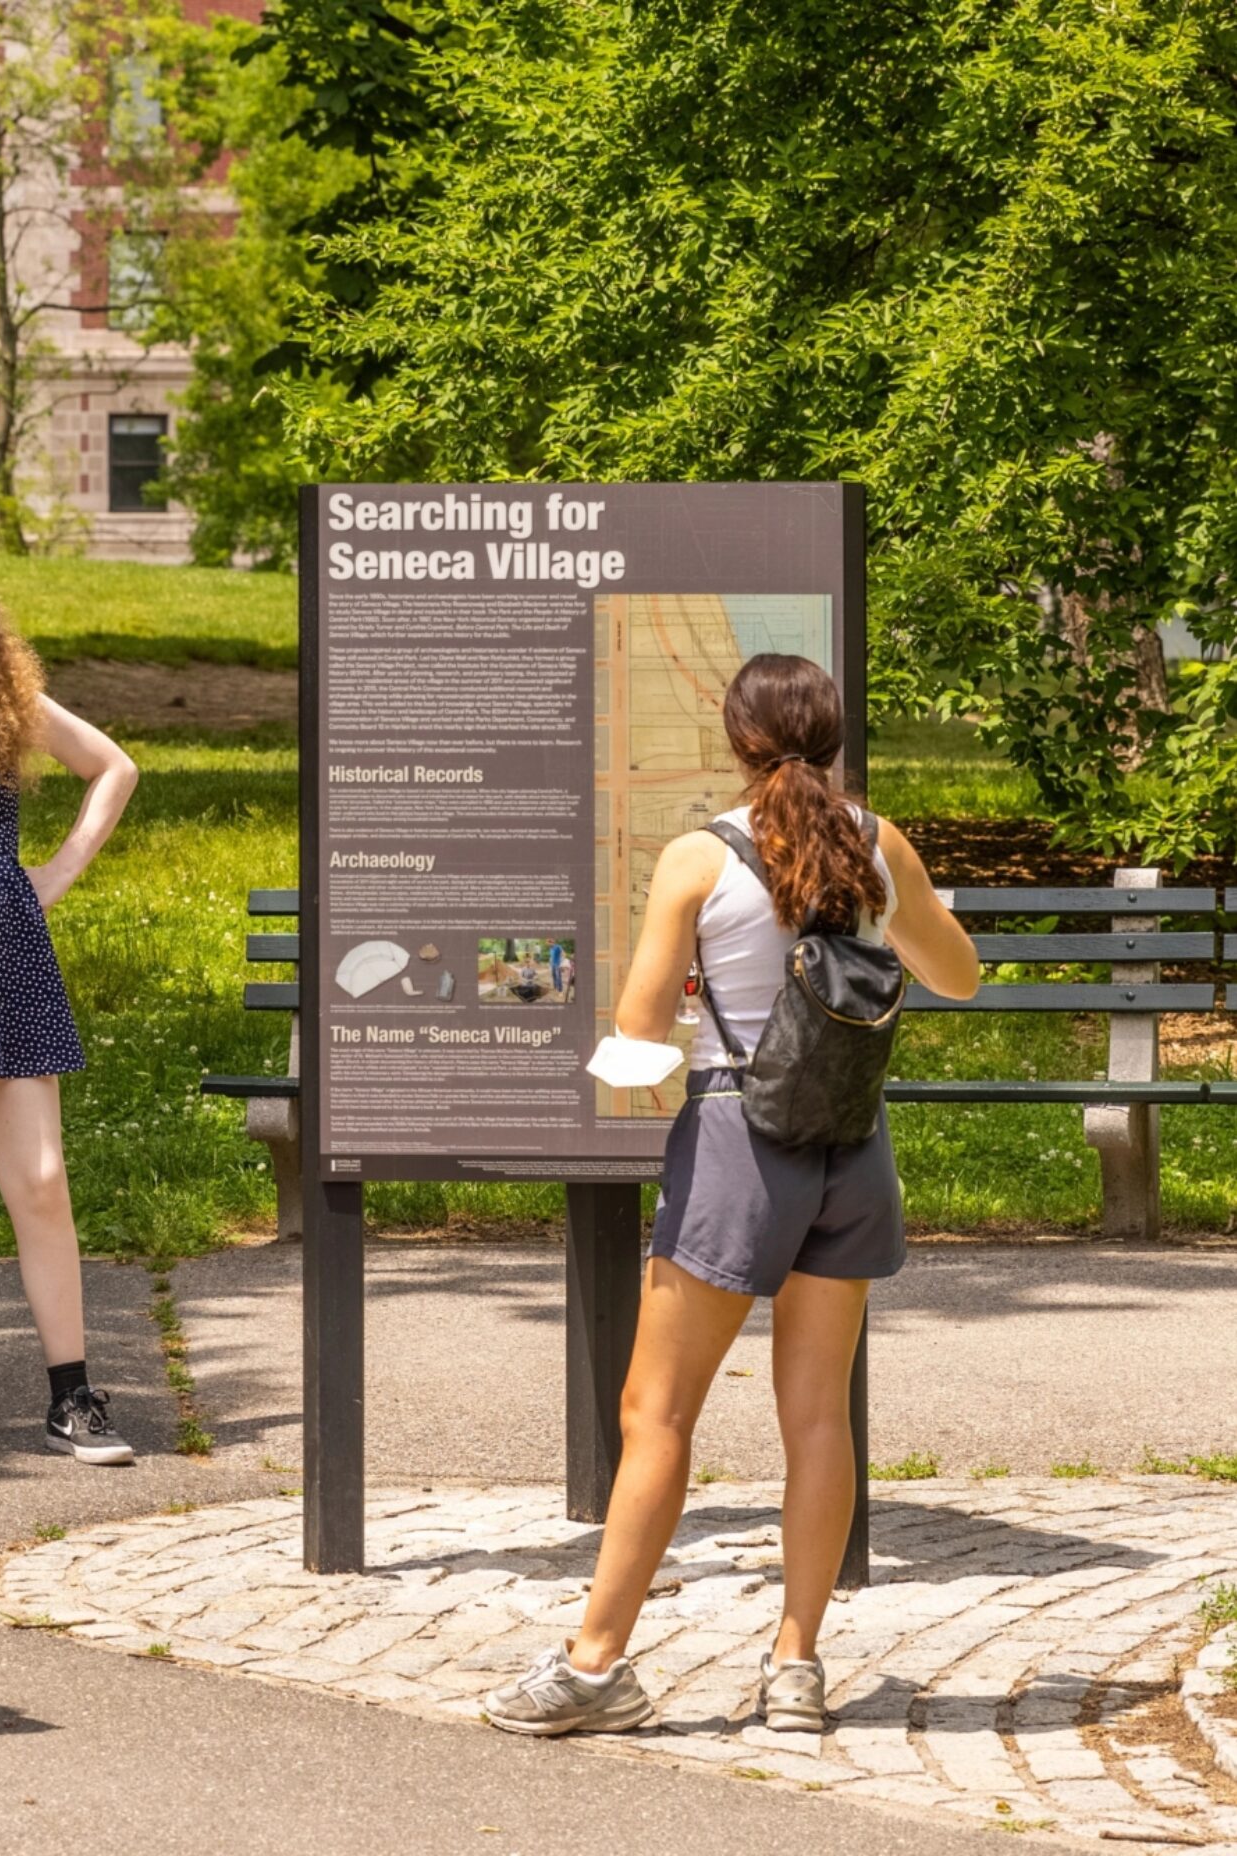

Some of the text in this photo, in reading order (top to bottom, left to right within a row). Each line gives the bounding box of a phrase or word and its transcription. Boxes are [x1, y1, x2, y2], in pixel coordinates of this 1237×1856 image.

[328, 492, 606, 539] Searching for
[328, 542, 625, 588] Seneca Village
[328, 765, 484, 783] Historical Records
[329, 851, 436, 872] Archaeology
[330, 1025, 561, 1047] The Name “Seneca Village”
